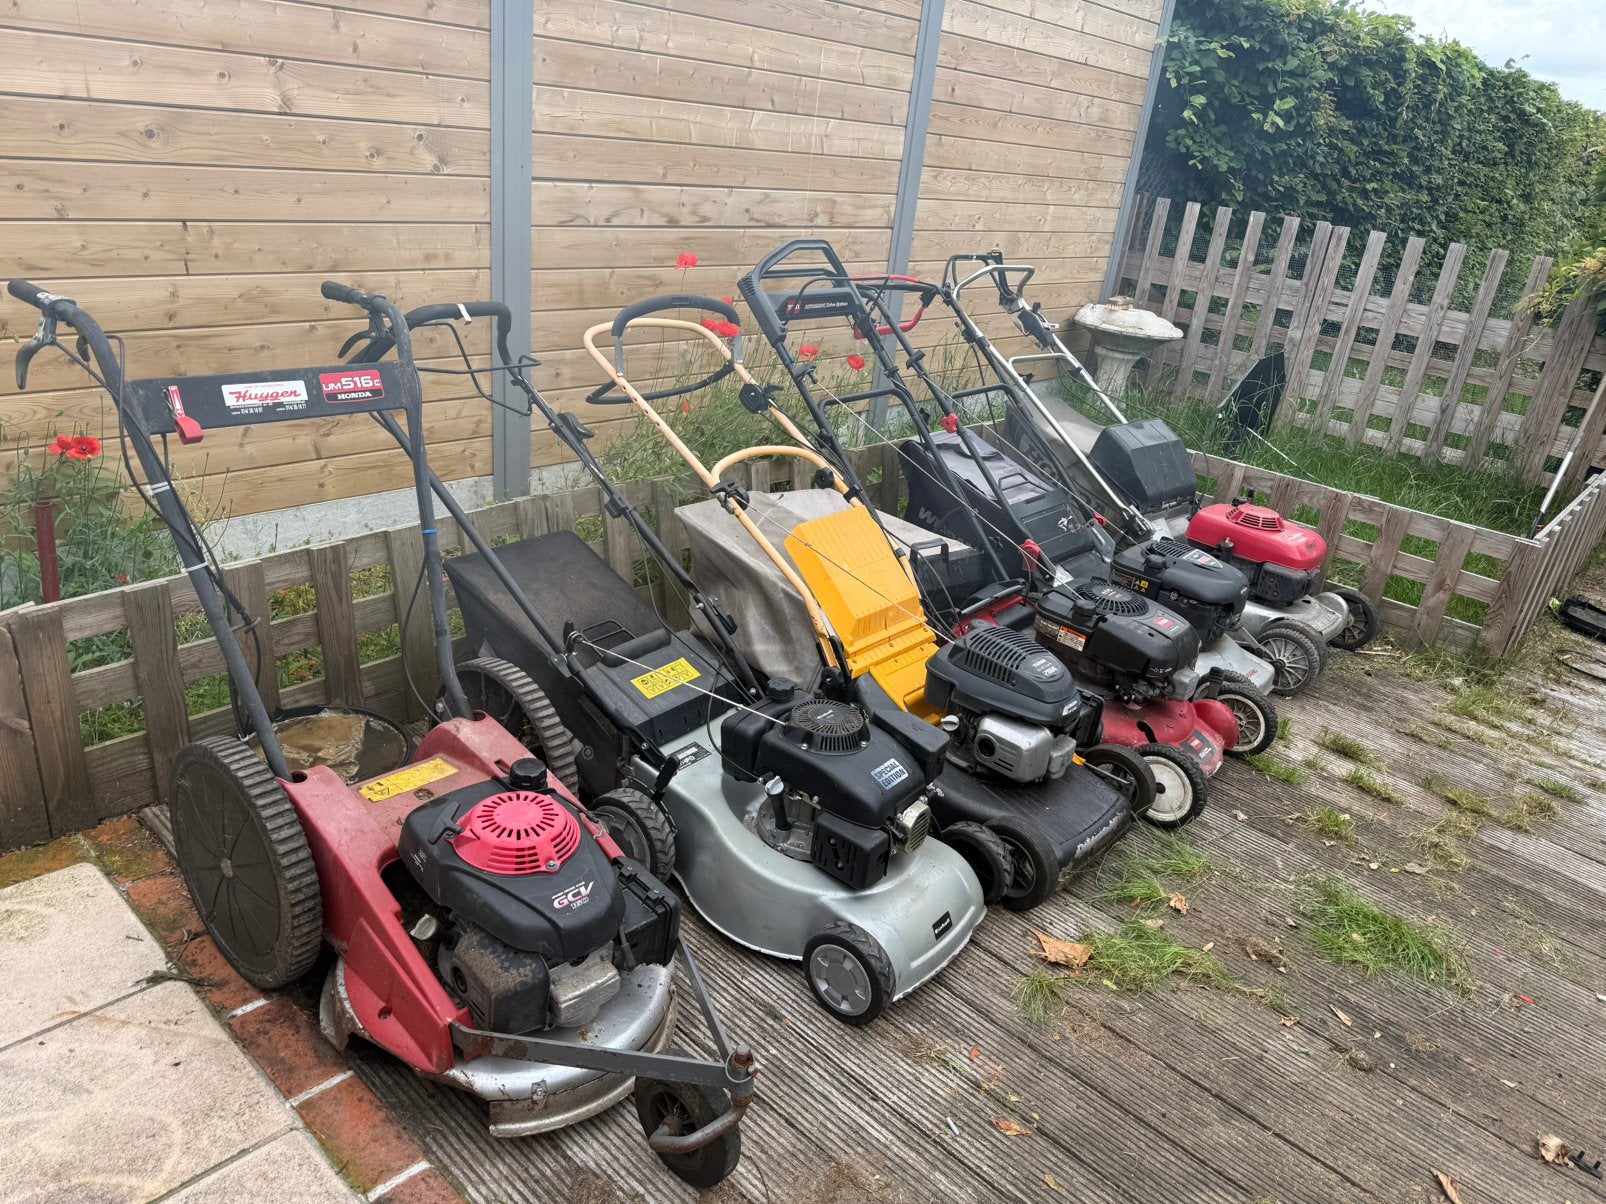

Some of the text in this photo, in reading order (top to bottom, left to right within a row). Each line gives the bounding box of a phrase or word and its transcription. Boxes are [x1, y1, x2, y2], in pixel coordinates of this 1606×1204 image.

[229, 389, 301, 402] Huygen
[337, 391, 373, 400] HONDA
[874, 761, 900, 780] SPECIAL
[880, 767, 906, 787] EDITION
[553, 881, 594, 909] GCV
